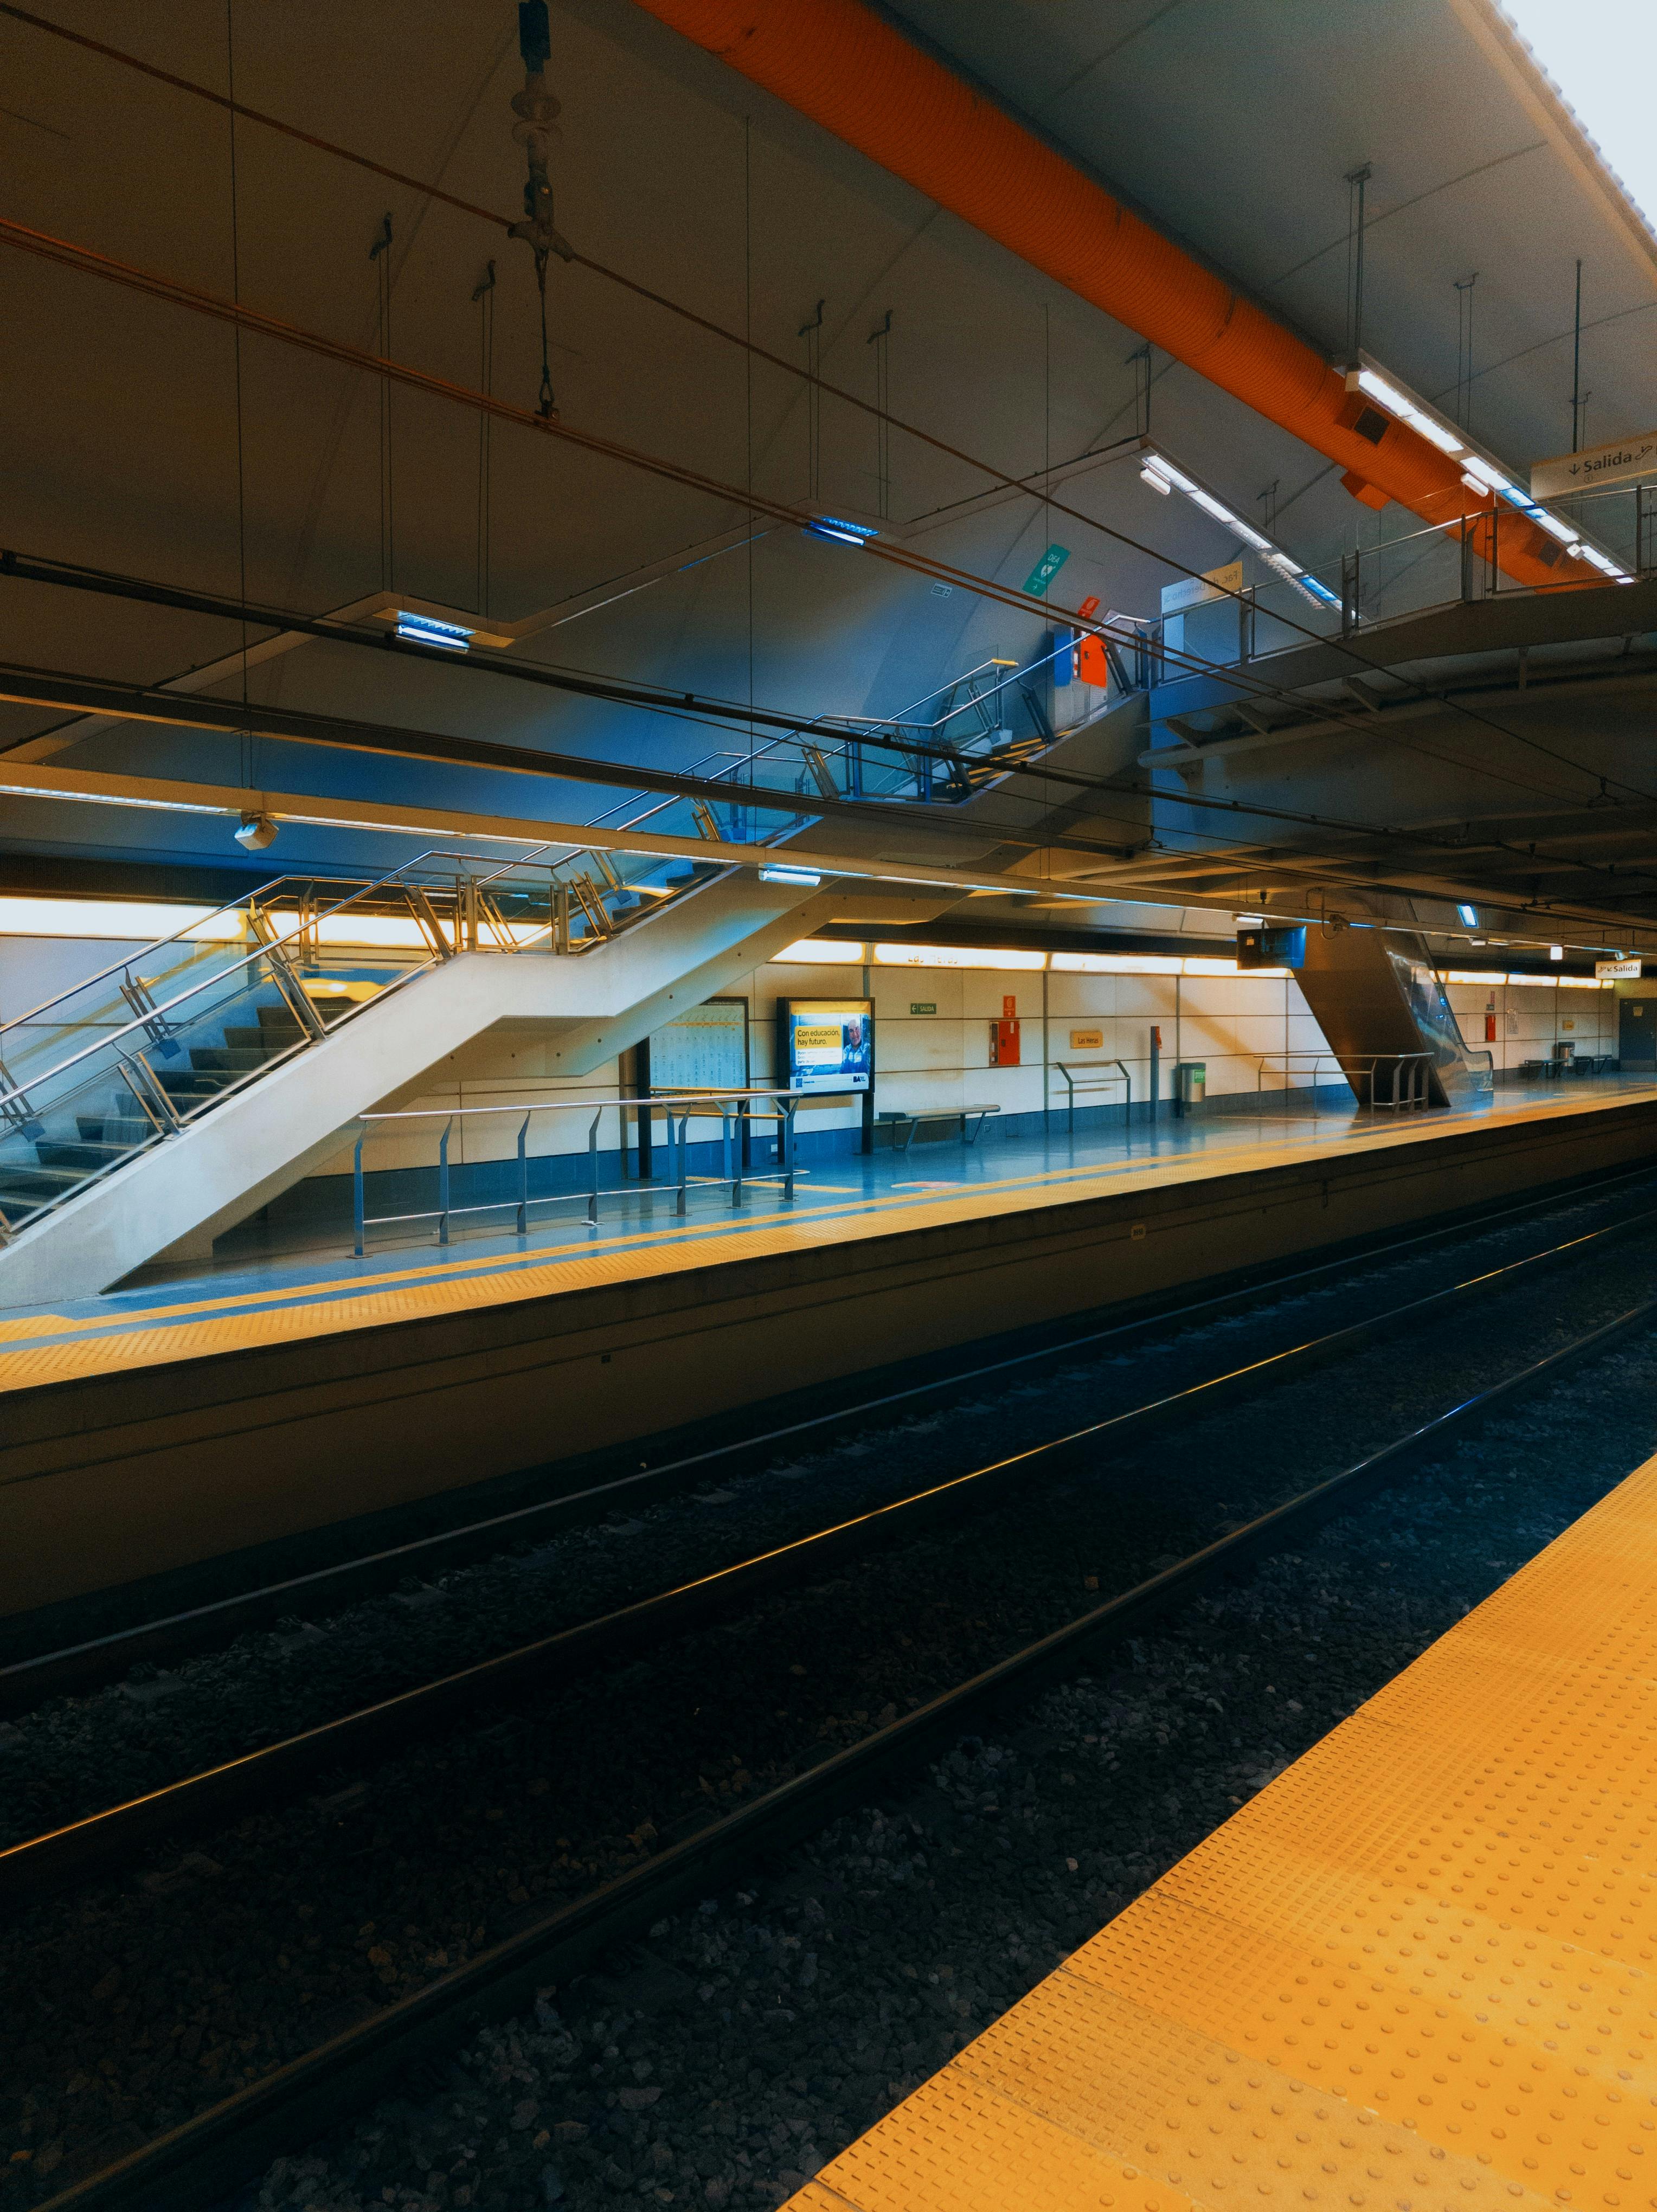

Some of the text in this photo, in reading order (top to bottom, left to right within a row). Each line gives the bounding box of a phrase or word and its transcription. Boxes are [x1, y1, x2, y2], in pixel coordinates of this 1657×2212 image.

[1584, 452, 1632, 472] Salida
[1048, 554, 1060, 563] DEA
[798, 1038, 808, 1046] hay
